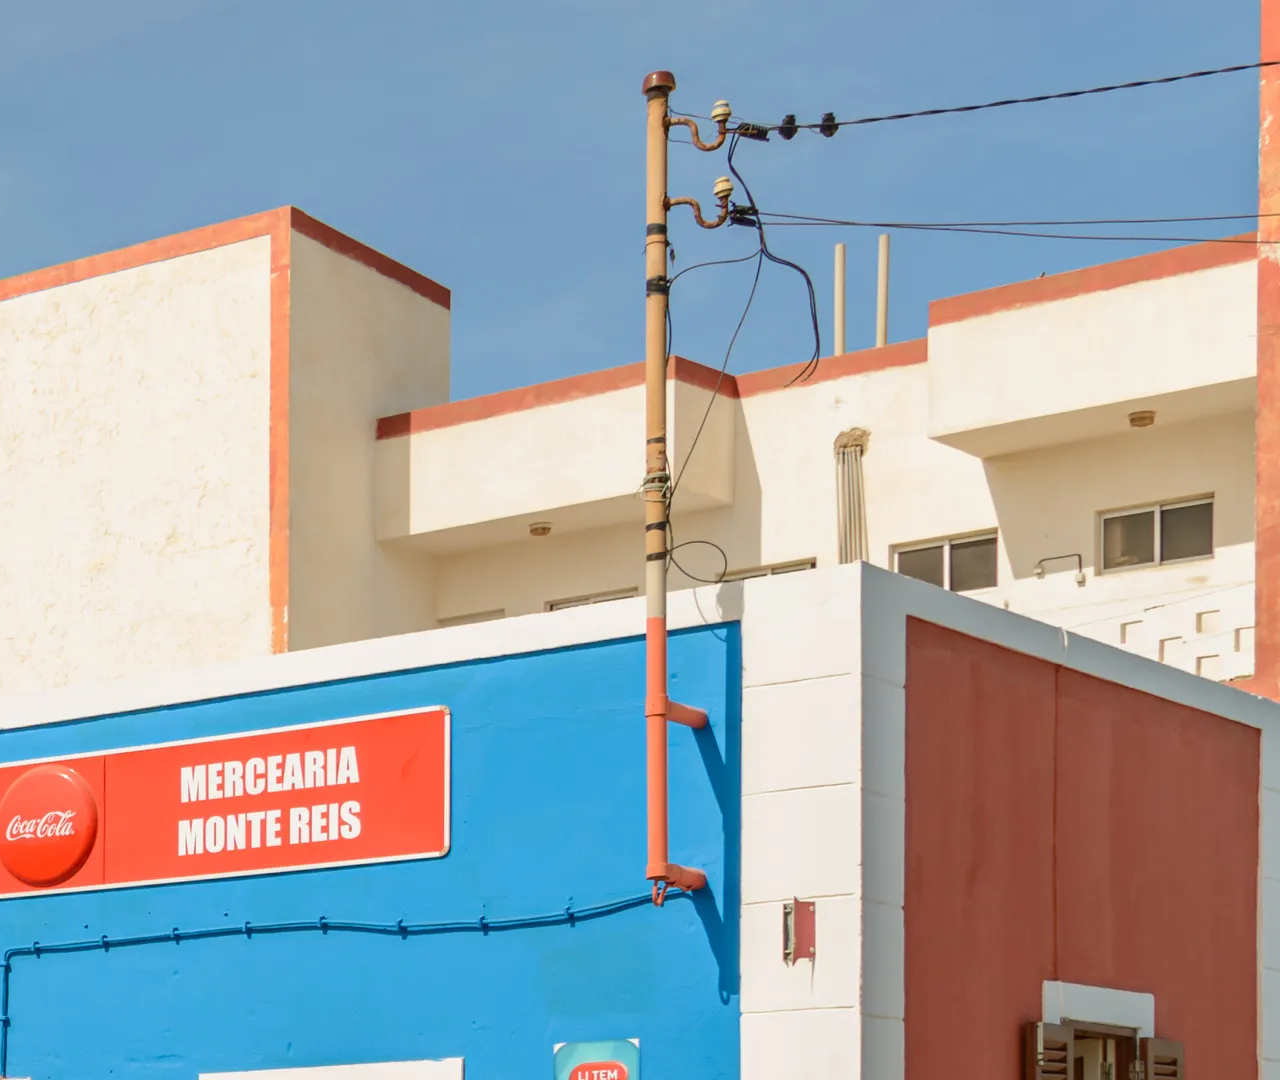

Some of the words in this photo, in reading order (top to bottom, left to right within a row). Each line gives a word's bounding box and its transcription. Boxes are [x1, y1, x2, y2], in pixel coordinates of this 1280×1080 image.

[180, 746, 360, 803] MERCEARIA
[5, 808, 77, 842] Coca-Cola
[177, 808, 282, 857] MONTE
[289, 800, 362, 845] REIS
[592, 1069, 618, 1080] TEM
